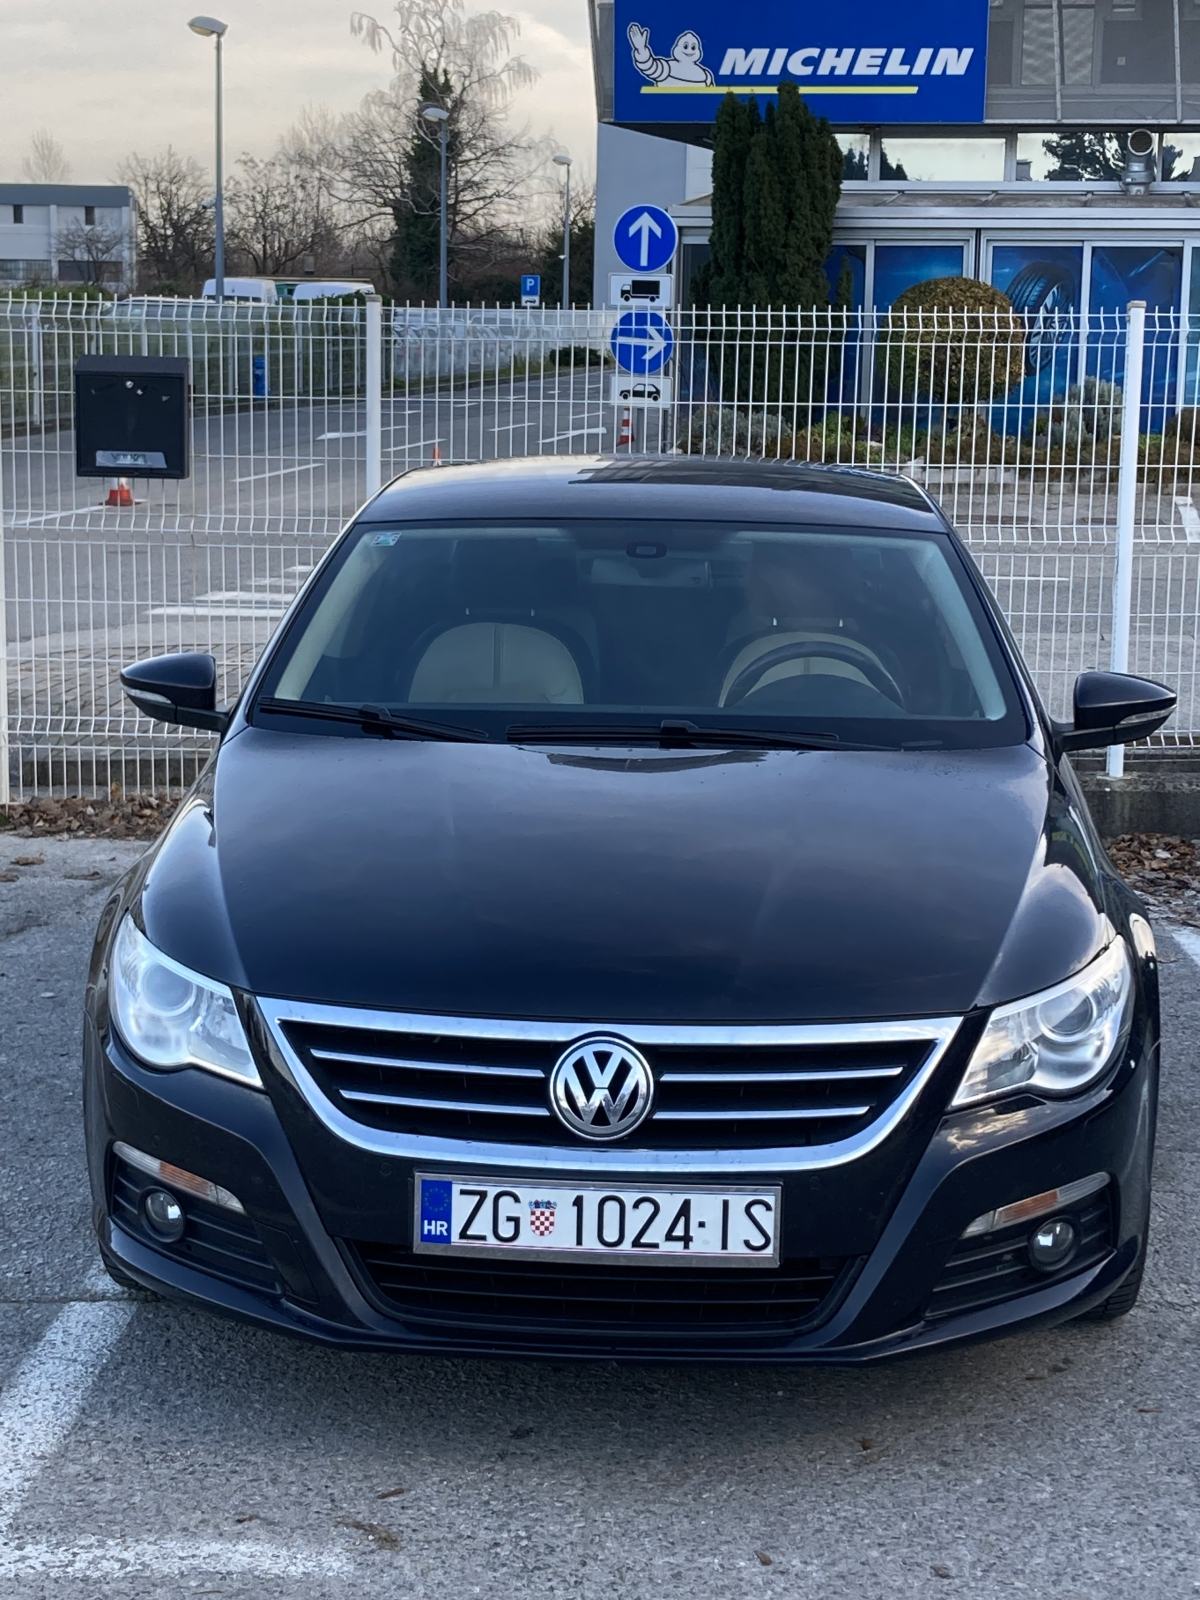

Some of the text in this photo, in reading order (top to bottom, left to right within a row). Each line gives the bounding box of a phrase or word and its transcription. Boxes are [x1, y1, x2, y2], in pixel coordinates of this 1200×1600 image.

[718, 47, 975, 76] MICHELIN
[526, 277, 535, 292] P
[458, 1188, 522, 1244] ZG
[423, 1219, 449, 1237] HR
